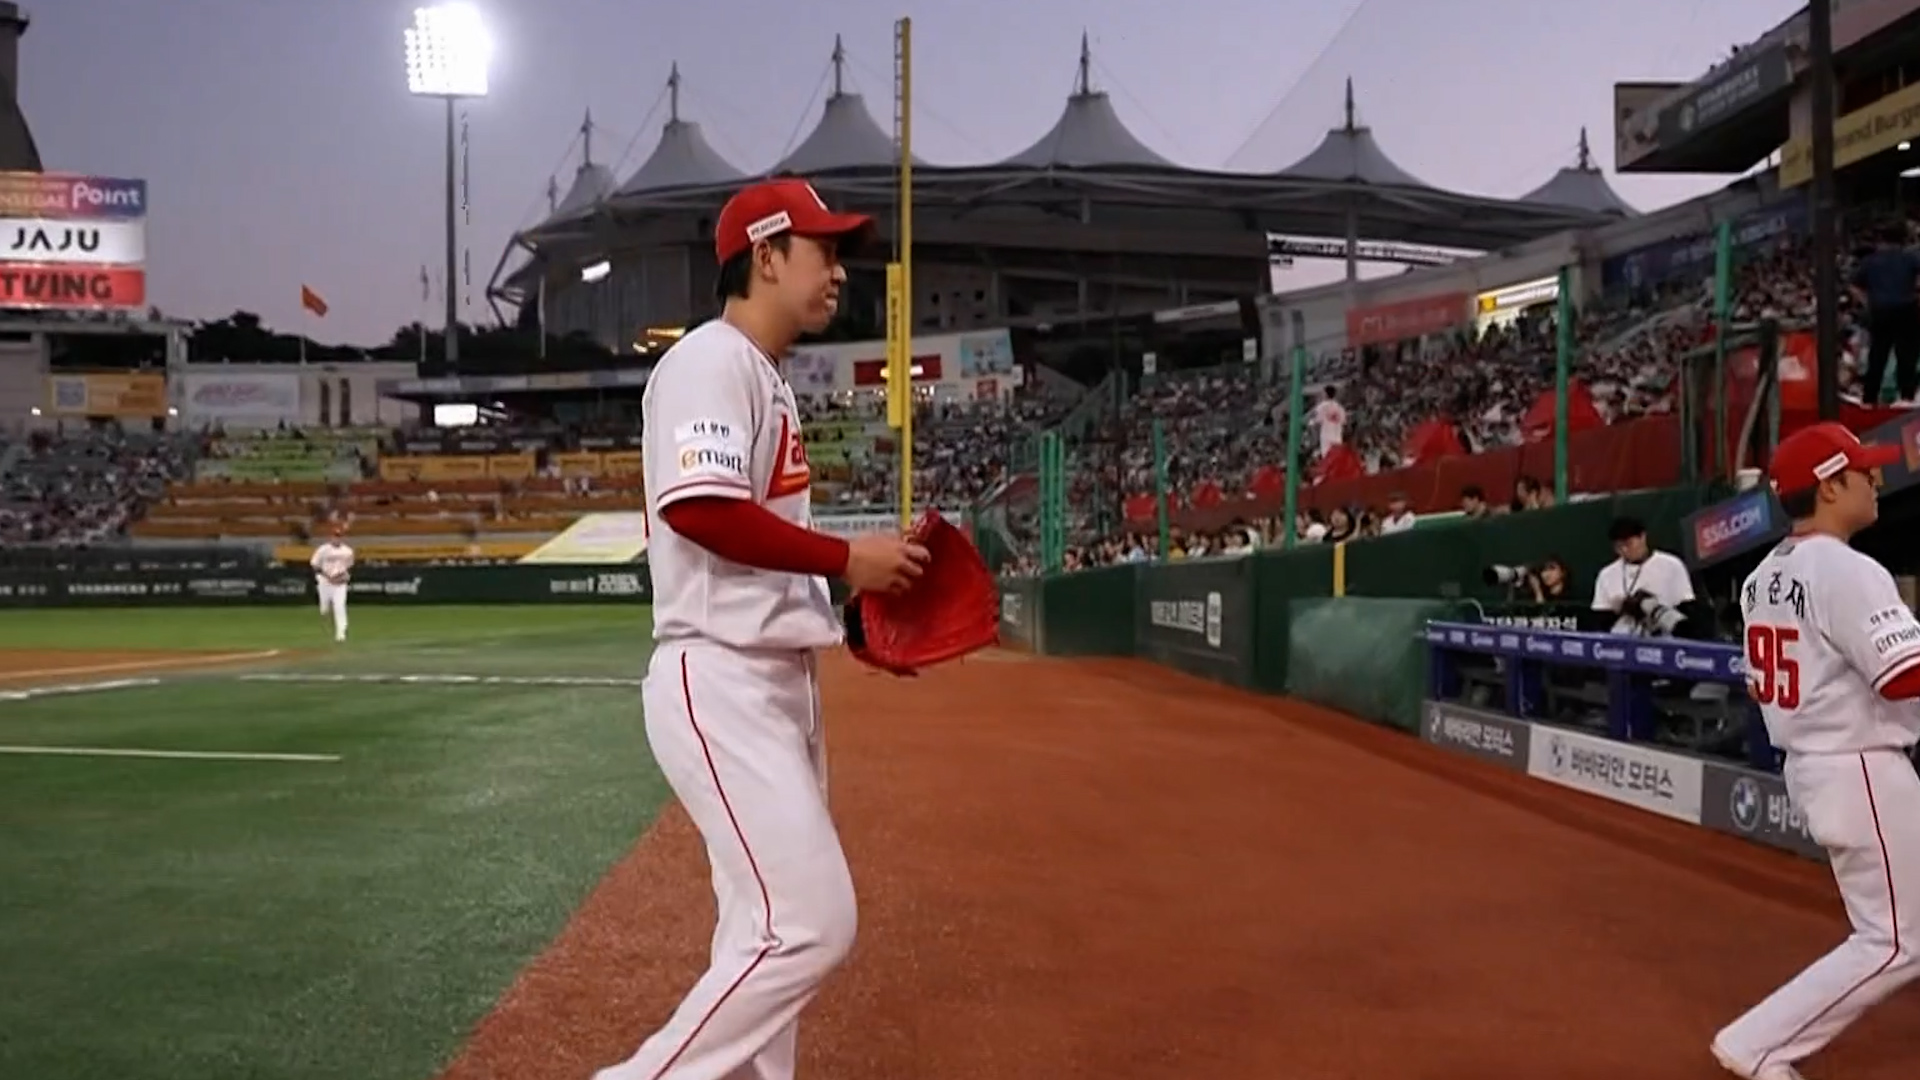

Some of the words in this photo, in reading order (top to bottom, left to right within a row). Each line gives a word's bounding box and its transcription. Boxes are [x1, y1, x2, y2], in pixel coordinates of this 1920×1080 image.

[72, 181, 140, 209] Point
[10, 227, 100, 252] JAJU
[0, 272, 113, 300] TVING
[681, 447, 743, 476] emart
[1701, 506, 1763, 547] SSG.COM
[1747, 625, 1800, 711] 95
[1571, 746, 1626, 788] 바바리안
[1628, 760, 1674, 799] 모터스
